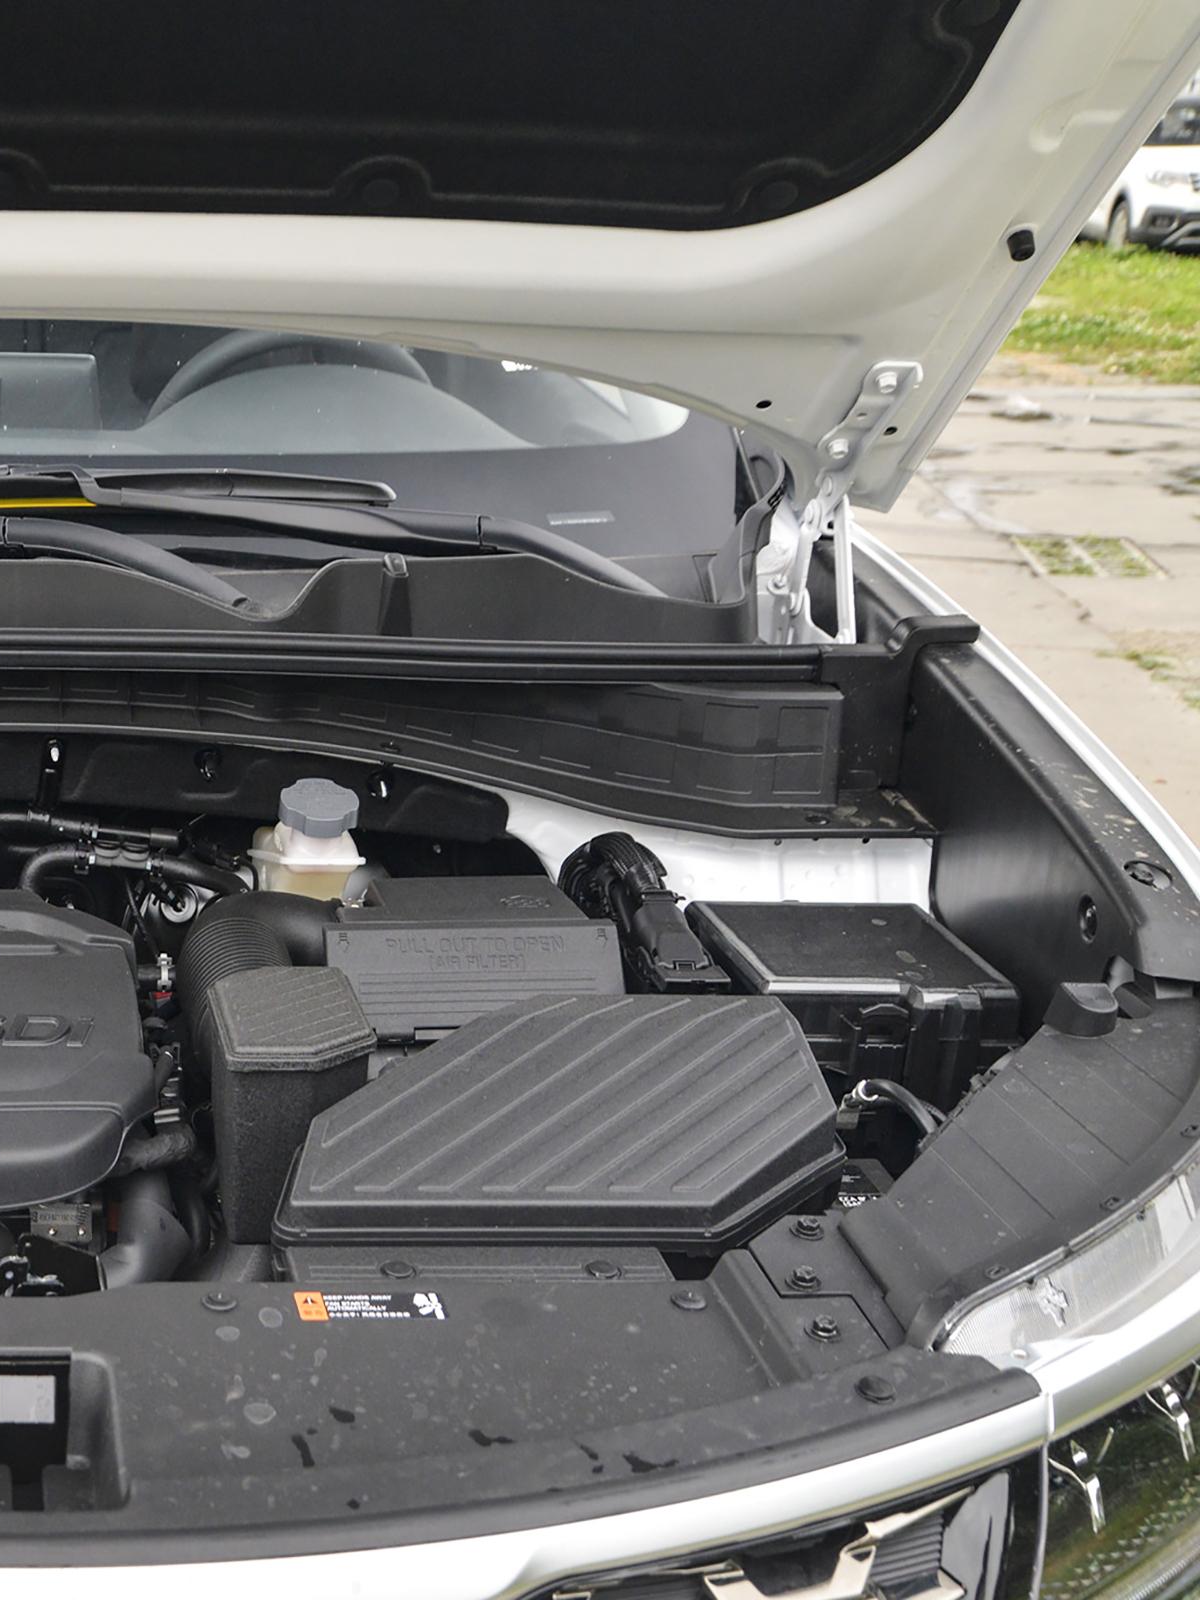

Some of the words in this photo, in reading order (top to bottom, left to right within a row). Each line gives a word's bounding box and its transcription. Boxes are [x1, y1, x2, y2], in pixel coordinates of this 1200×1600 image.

[385, 936, 434, 954] PULL
[439, 937, 478, 953] OUT
[482, 936, 508, 952] TO
[513, 935, 565, 952] OPEN
